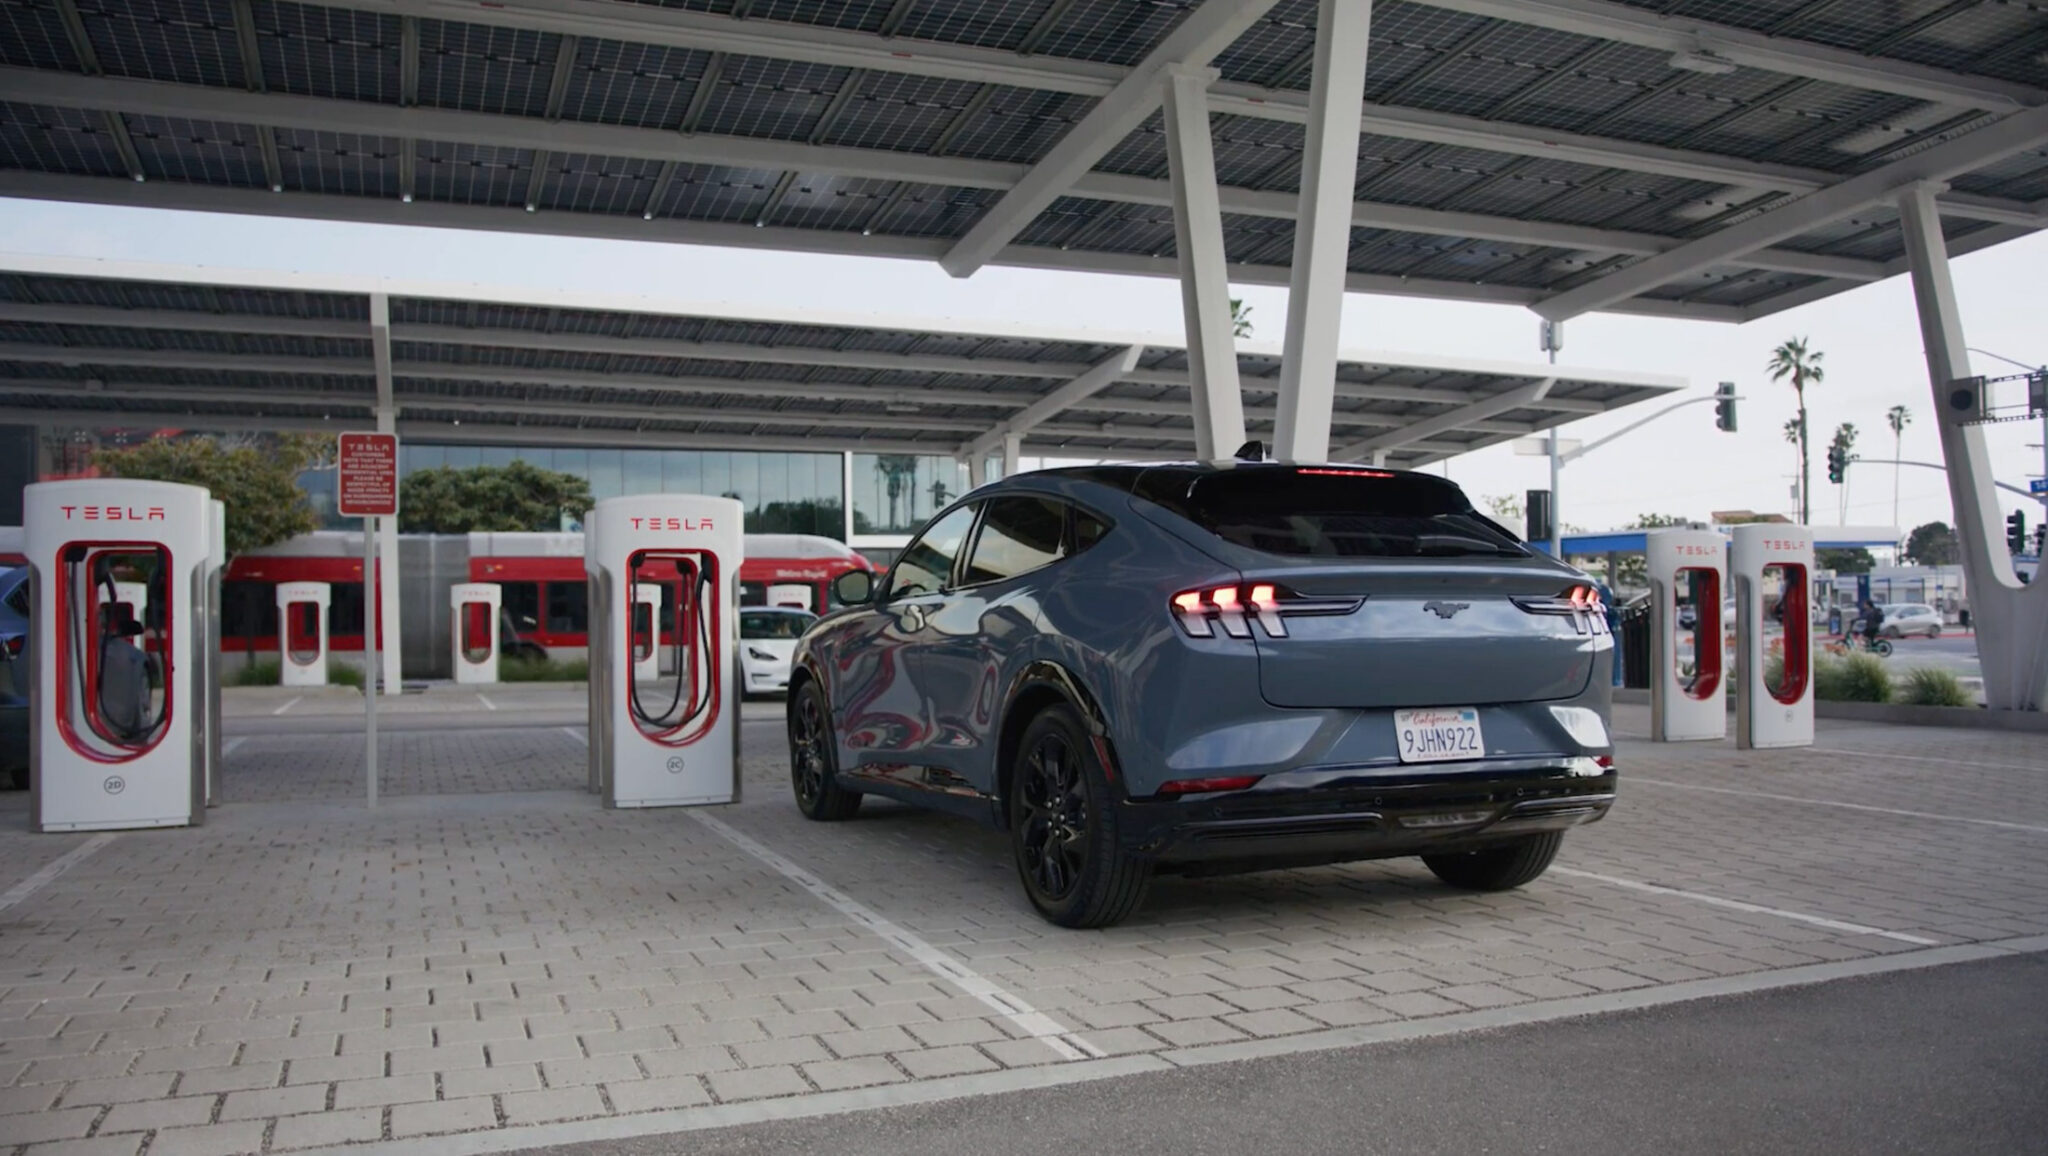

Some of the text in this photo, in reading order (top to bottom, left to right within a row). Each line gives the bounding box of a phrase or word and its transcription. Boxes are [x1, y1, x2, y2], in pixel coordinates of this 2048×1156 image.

[348, 443, 390, 451] TESLA
[61, 506, 165, 520] TESLA
[630, 518, 713, 530] TESLA
[1676, 546, 1718, 555] TESLA
[1764, 540, 1805, 550] TESLA
[1412, 711, 1462, 727] California
[1404, 727, 1478, 753] 9JHN922
